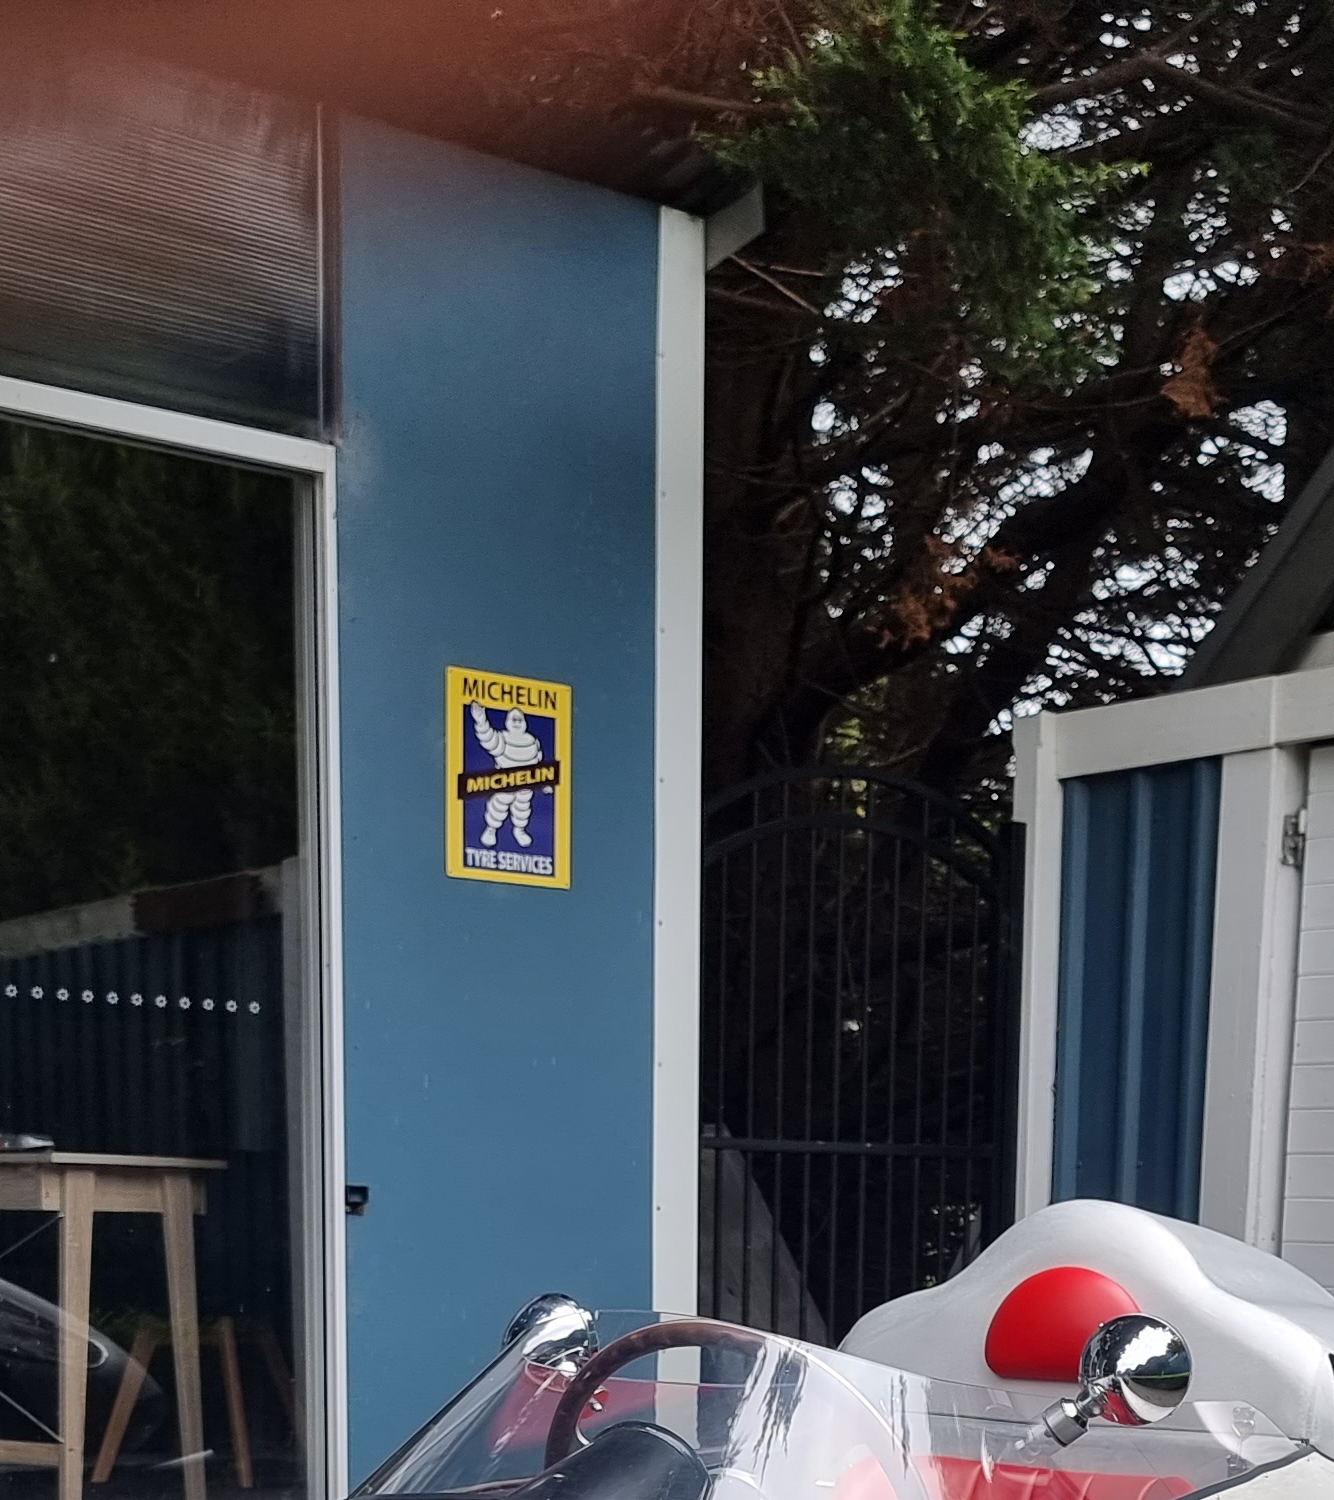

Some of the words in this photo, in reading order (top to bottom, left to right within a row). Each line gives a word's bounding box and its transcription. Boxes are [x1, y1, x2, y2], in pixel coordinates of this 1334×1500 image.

[462, 678, 557, 710] MICHELIN
[467, 766, 555, 793] MICHELIN
[465, 847, 497, 869] TYRE
[497, 851, 553, 875] SERVICES
